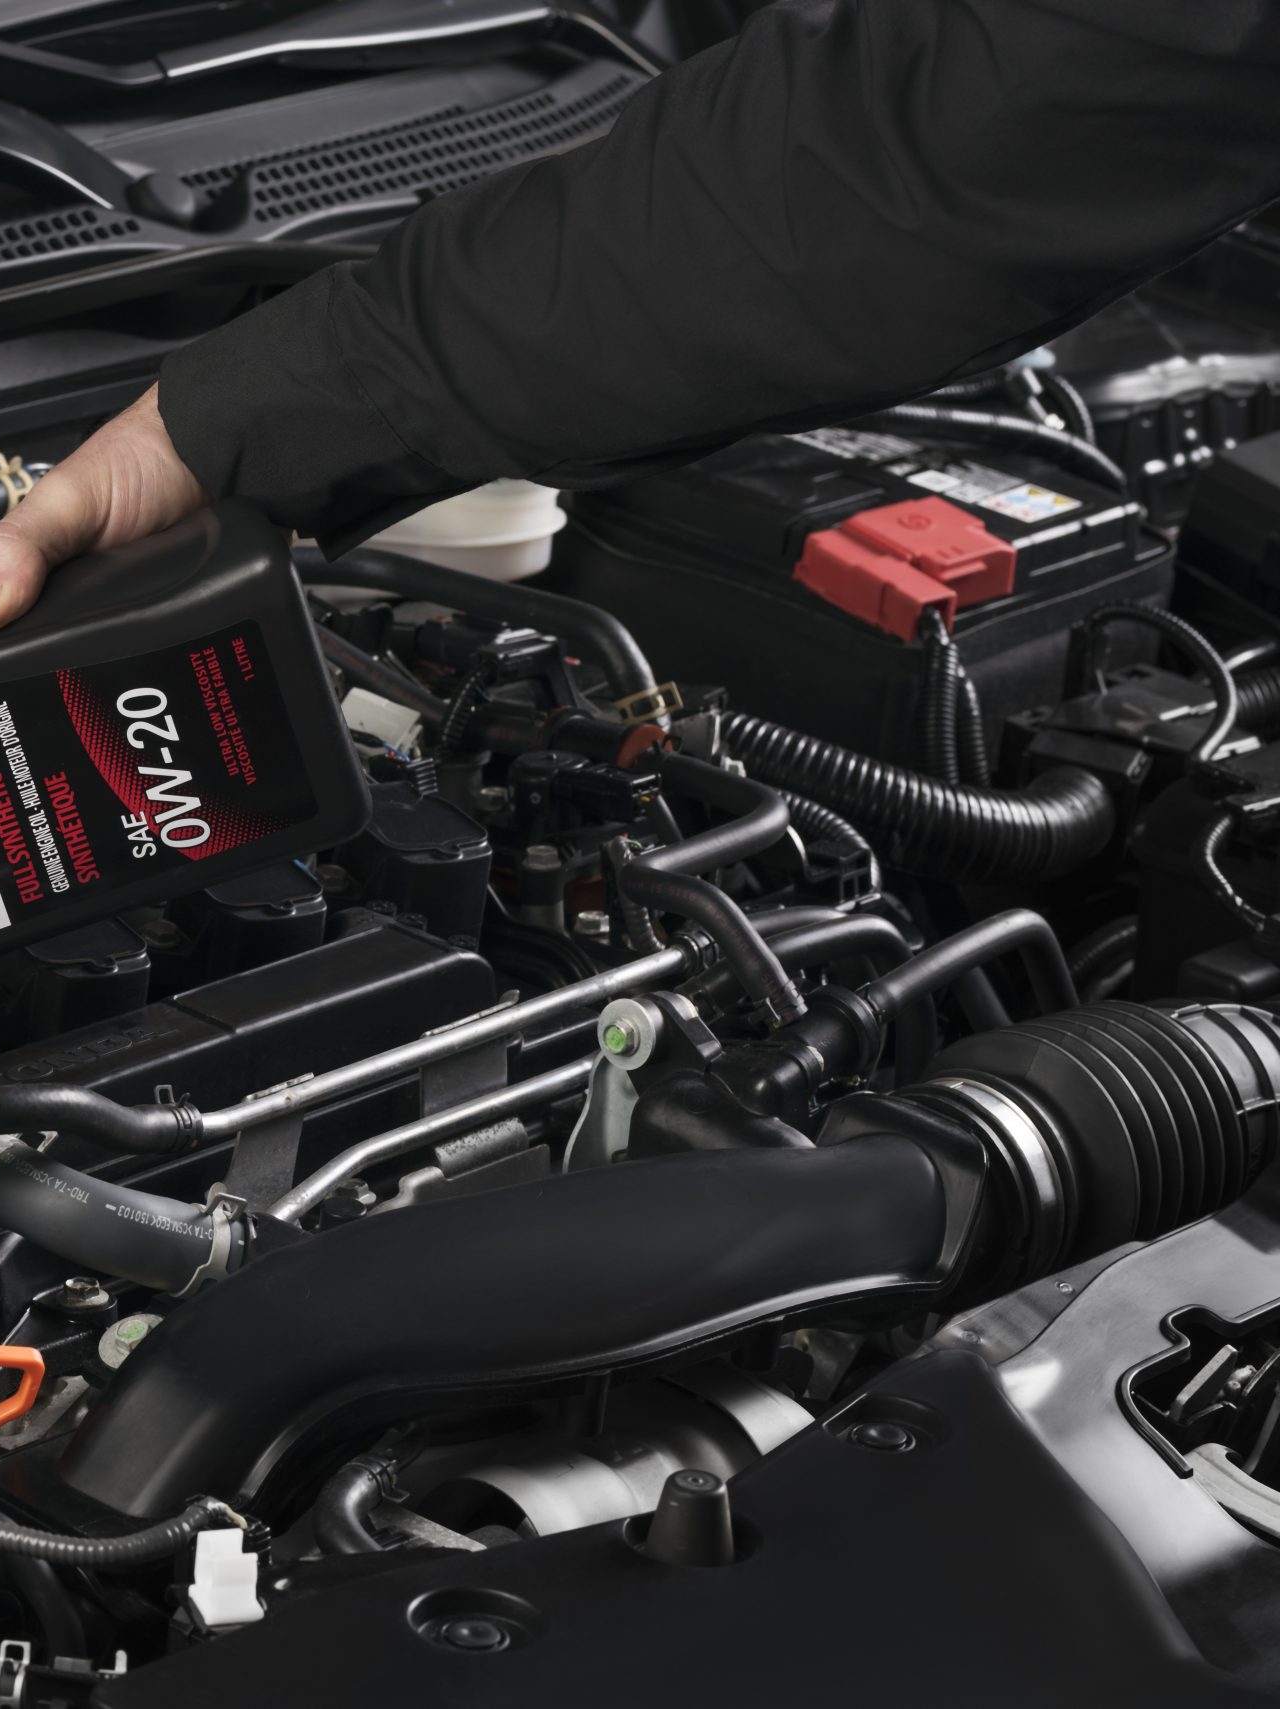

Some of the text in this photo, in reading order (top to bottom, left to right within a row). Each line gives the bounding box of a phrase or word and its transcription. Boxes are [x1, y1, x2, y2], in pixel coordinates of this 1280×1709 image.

[231, 637, 252, 673] LITRE
[190, 653, 240, 777] ULTRA LOW VISCOSITY
[204, 647, 257, 786] VISCOSITÉ ULTRA FAIBLE
[5, 744, 33, 784] MOTEUR
[116, 687, 211, 848] 0W-20
[17, 779, 42, 810] HUILE
[28, 808, 48, 828] OIL
[43, 771, 100, 884] SYNTHÉTIQUE
[121, 811, 157, 859] SAE
[32, 823, 59, 859] ENGINE
[13, 860, 44, 904] FULL
[43, 854, 70, 893] GENUINE
[54, 1178, 90, 1204] TRD-TA
